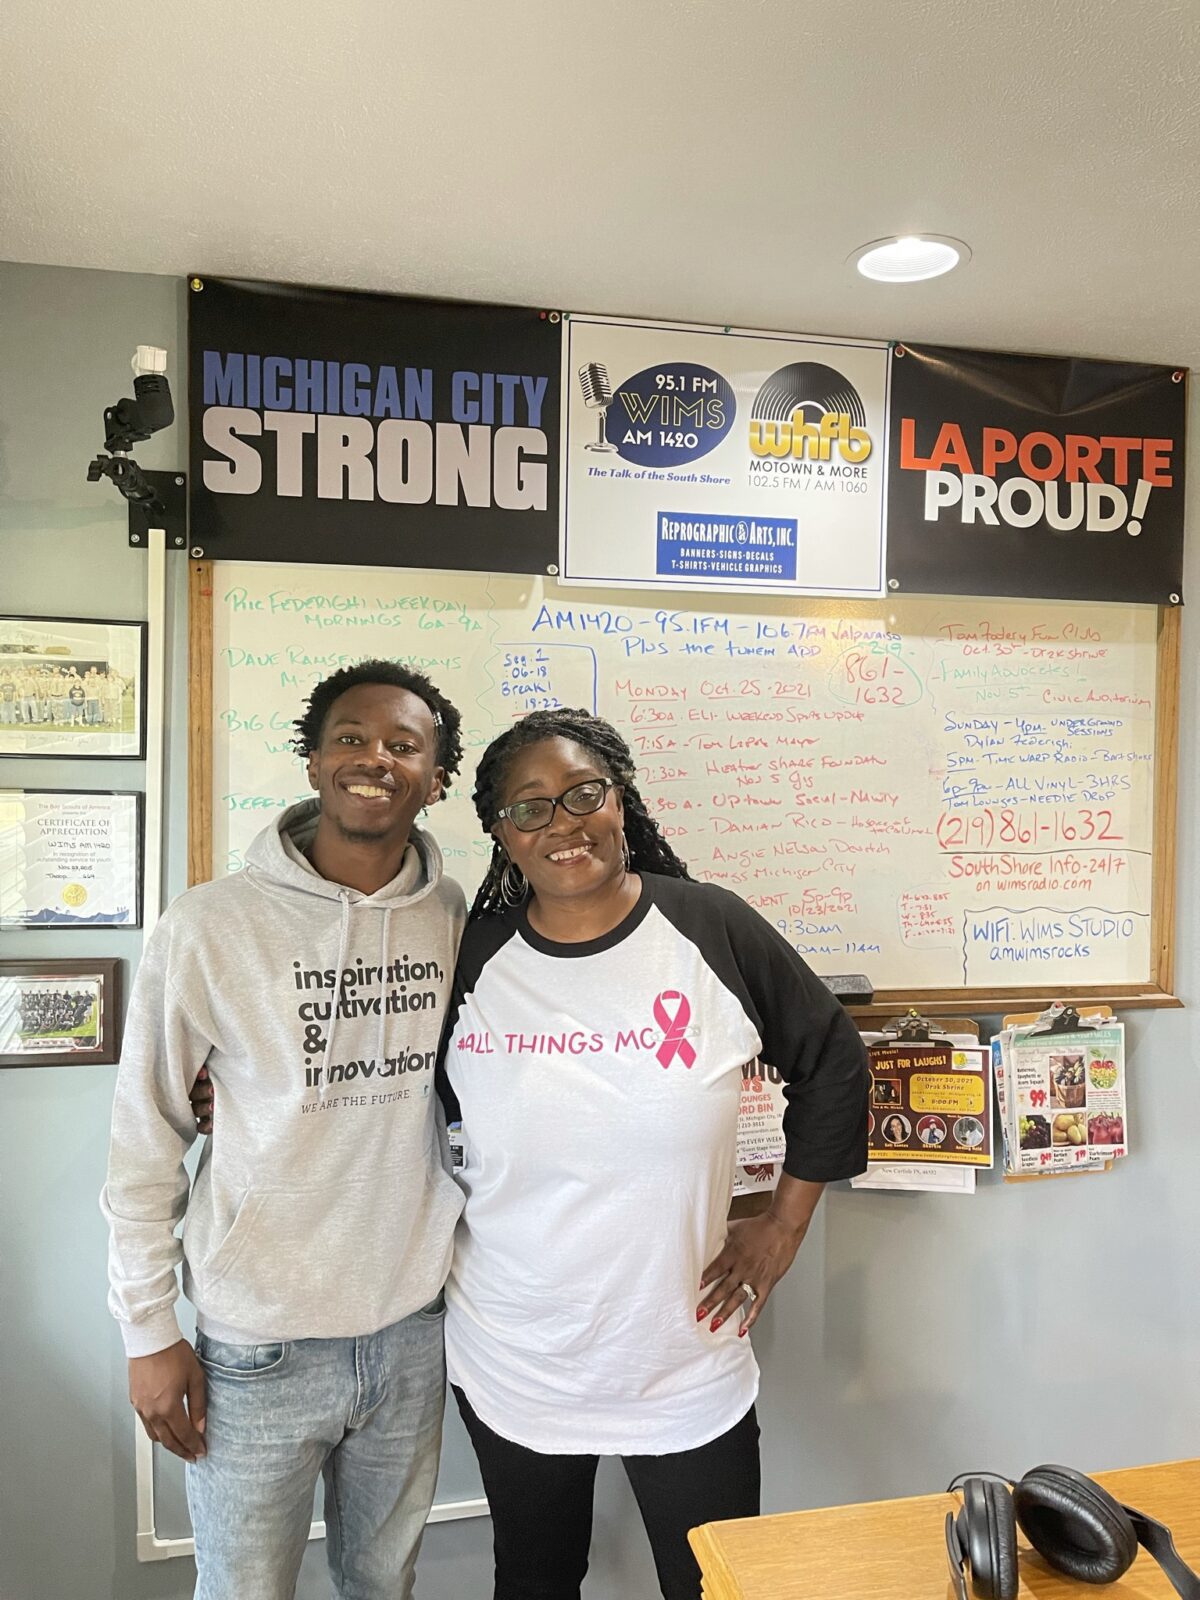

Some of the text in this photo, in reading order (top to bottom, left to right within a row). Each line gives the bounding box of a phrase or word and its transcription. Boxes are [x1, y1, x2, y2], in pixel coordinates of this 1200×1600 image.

[202, 350, 549, 428] MICHIGAN CITY
[655, 374, 718, 394] 95.1 FM
[619, 392, 726, 430] WIMS
[622, 429, 699, 449] AM 1420
[749, 409, 872, 464] whfb
[202, 406, 548, 511] STRONG
[900, 418, 1173, 488] LA PORTE
[587, 467, 731, 485] The Talk of the South Shore
[749, 460, 868, 479] MOTOWN & MORE
[748, 475, 779, 488] 102.5
[783, 477, 801, 489] FM
[814, 481, 835, 492] AM
[841, 481, 868, 493] 1060
[924, 470, 1153, 537] PROUD!
[661, 517, 736, 544] REPROGRAPHIC
[744, 564, 783, 574] GRAPHICS
[620, 636, 669, 657] Plus
[679, 642, 715, 656] the
[854, 686, 905, 705] 1632
[37, 819, 97, 827] CERTIFICATE
[40, 828, 108, 836] APPRECIATION
[976, 880, 991, 892] on
[1068, 914, 1134, 939] STUDIO
[302, 1024, 328, 1055] &
[456, 1027, 657, 1055] #ALL THINGS MC
[875, 1060, 894, 1070] JUST
[897, 1058, 911, 1068] FOR
[301, 1089, 410, 1115] WE ARE THE FUTURE
[741, 1093, 772, 1104] OUNGES
[757, 1103, 774, 1113] BIN
